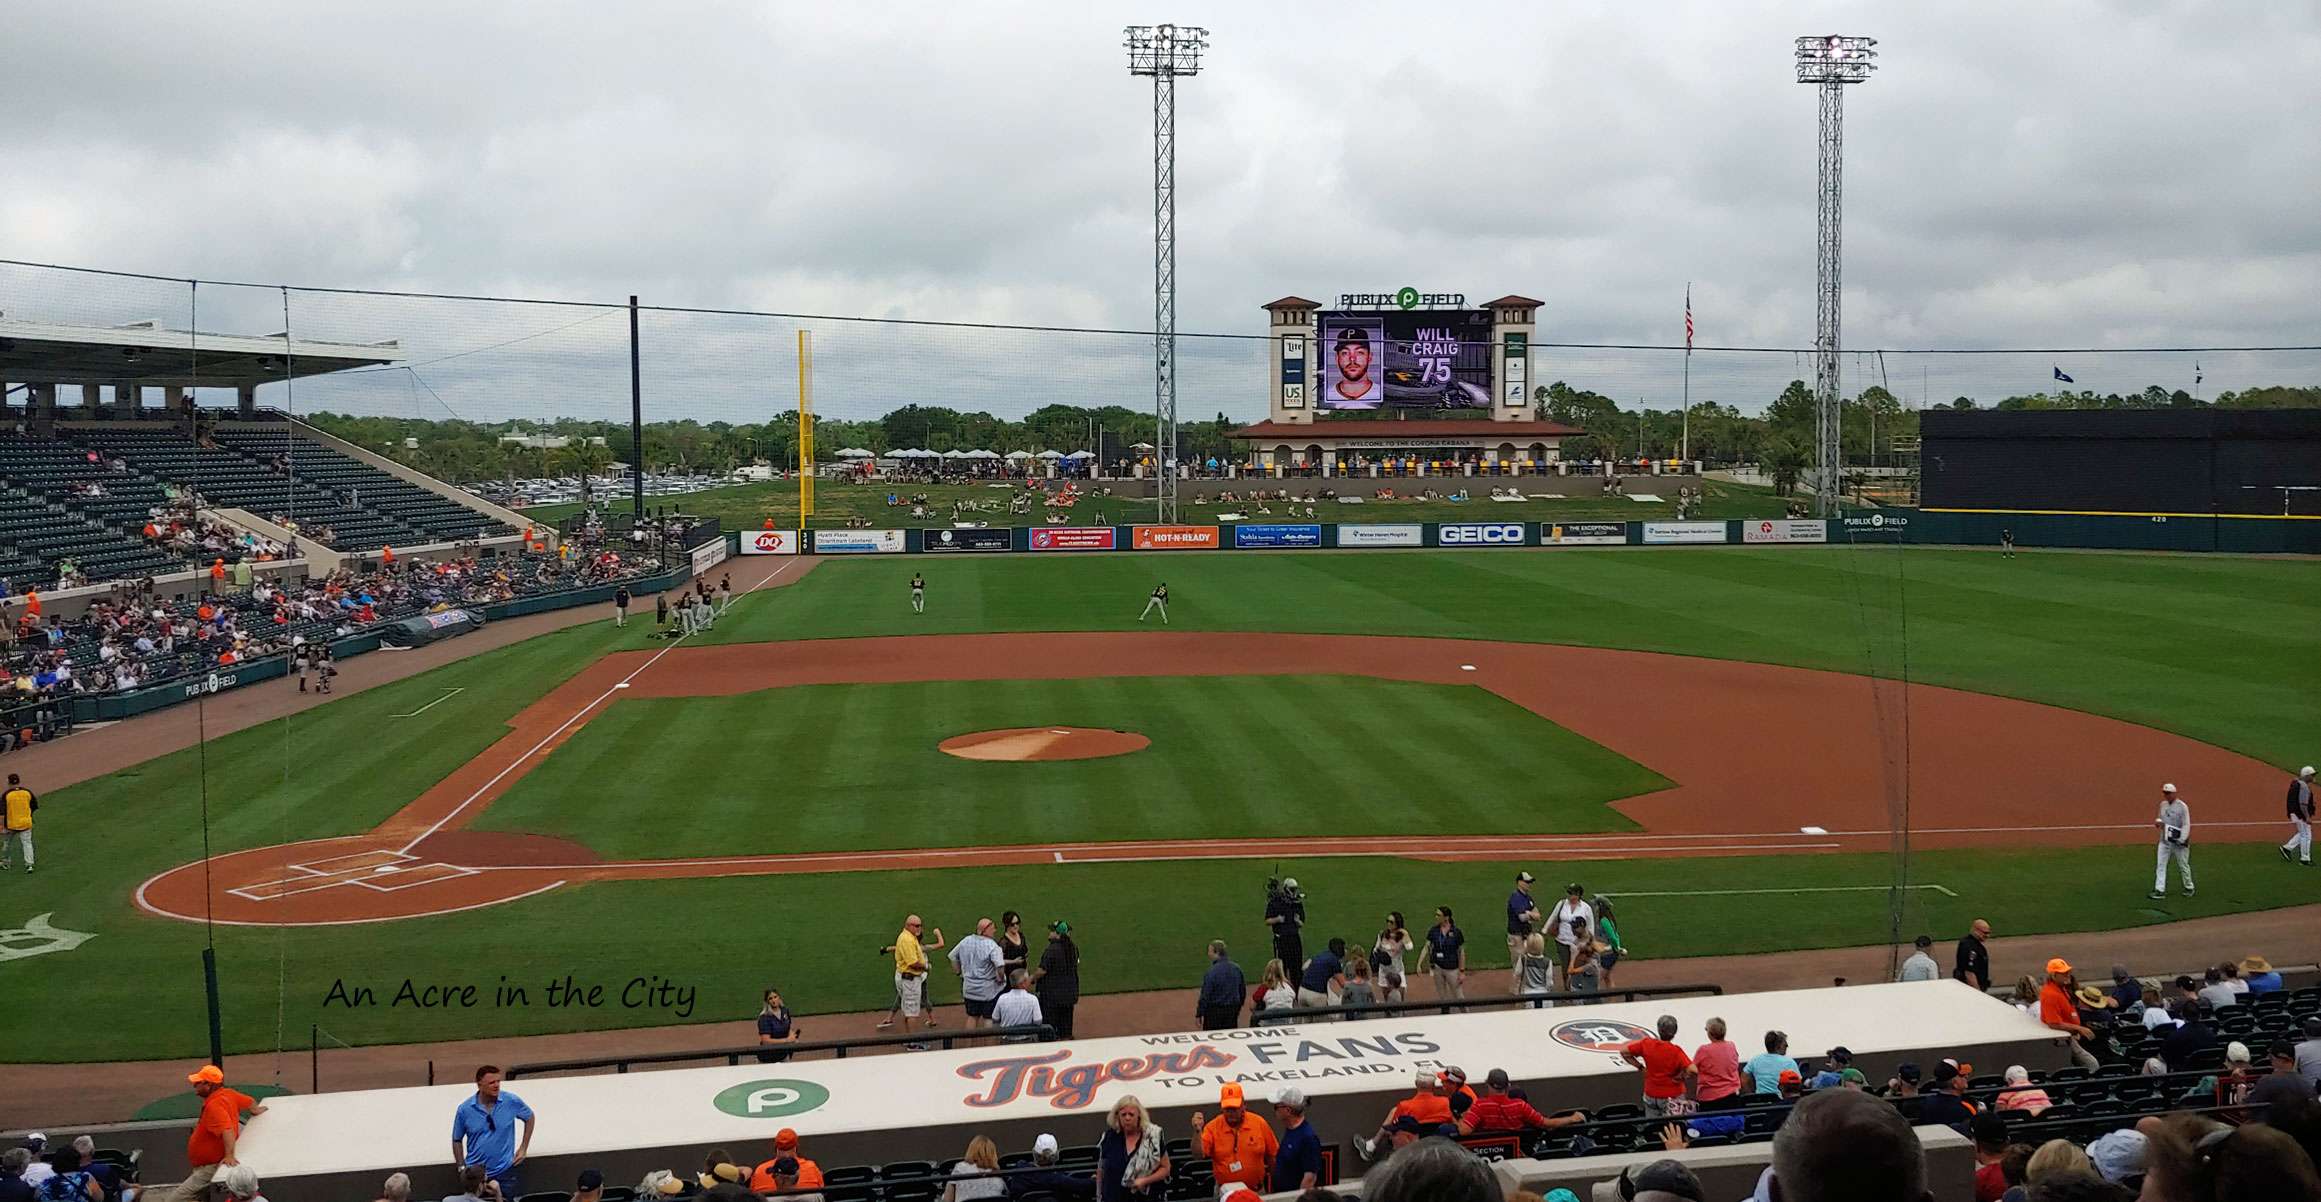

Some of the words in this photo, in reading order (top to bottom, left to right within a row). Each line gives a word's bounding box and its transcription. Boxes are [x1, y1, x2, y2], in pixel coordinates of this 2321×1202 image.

[1340, 294, 1393, 306] PUBLIX
[1422, 293, 1465, 306] FIELD
[1416, 328, 1454, 341] WILL
[1412, 343, 1459, 355] CRAIG
[1418, 357, 1452, 382] 75
[1844, 517, 1871, 525] PUBLIX
[1885, 517, 1908, 525] FIELD
[1154, 533, 1211, 543] HOT-N-READY
[1440, 526, 1523, 543] GEICO
[760, 537, 778, 548] DQ
[185, 681, 209, 697] PUBIX
[219, 675, 237, 688] FIELD
[1141, 1026, 1301, 1047] WELCOME
[957, 1044, 1239, 1110] Tigers
[1246, 1032, 1441, 1065] FANS
[1154, 1075, 1205, 1090] TO
[1473, 1146, 1505, 1155] SECTION
